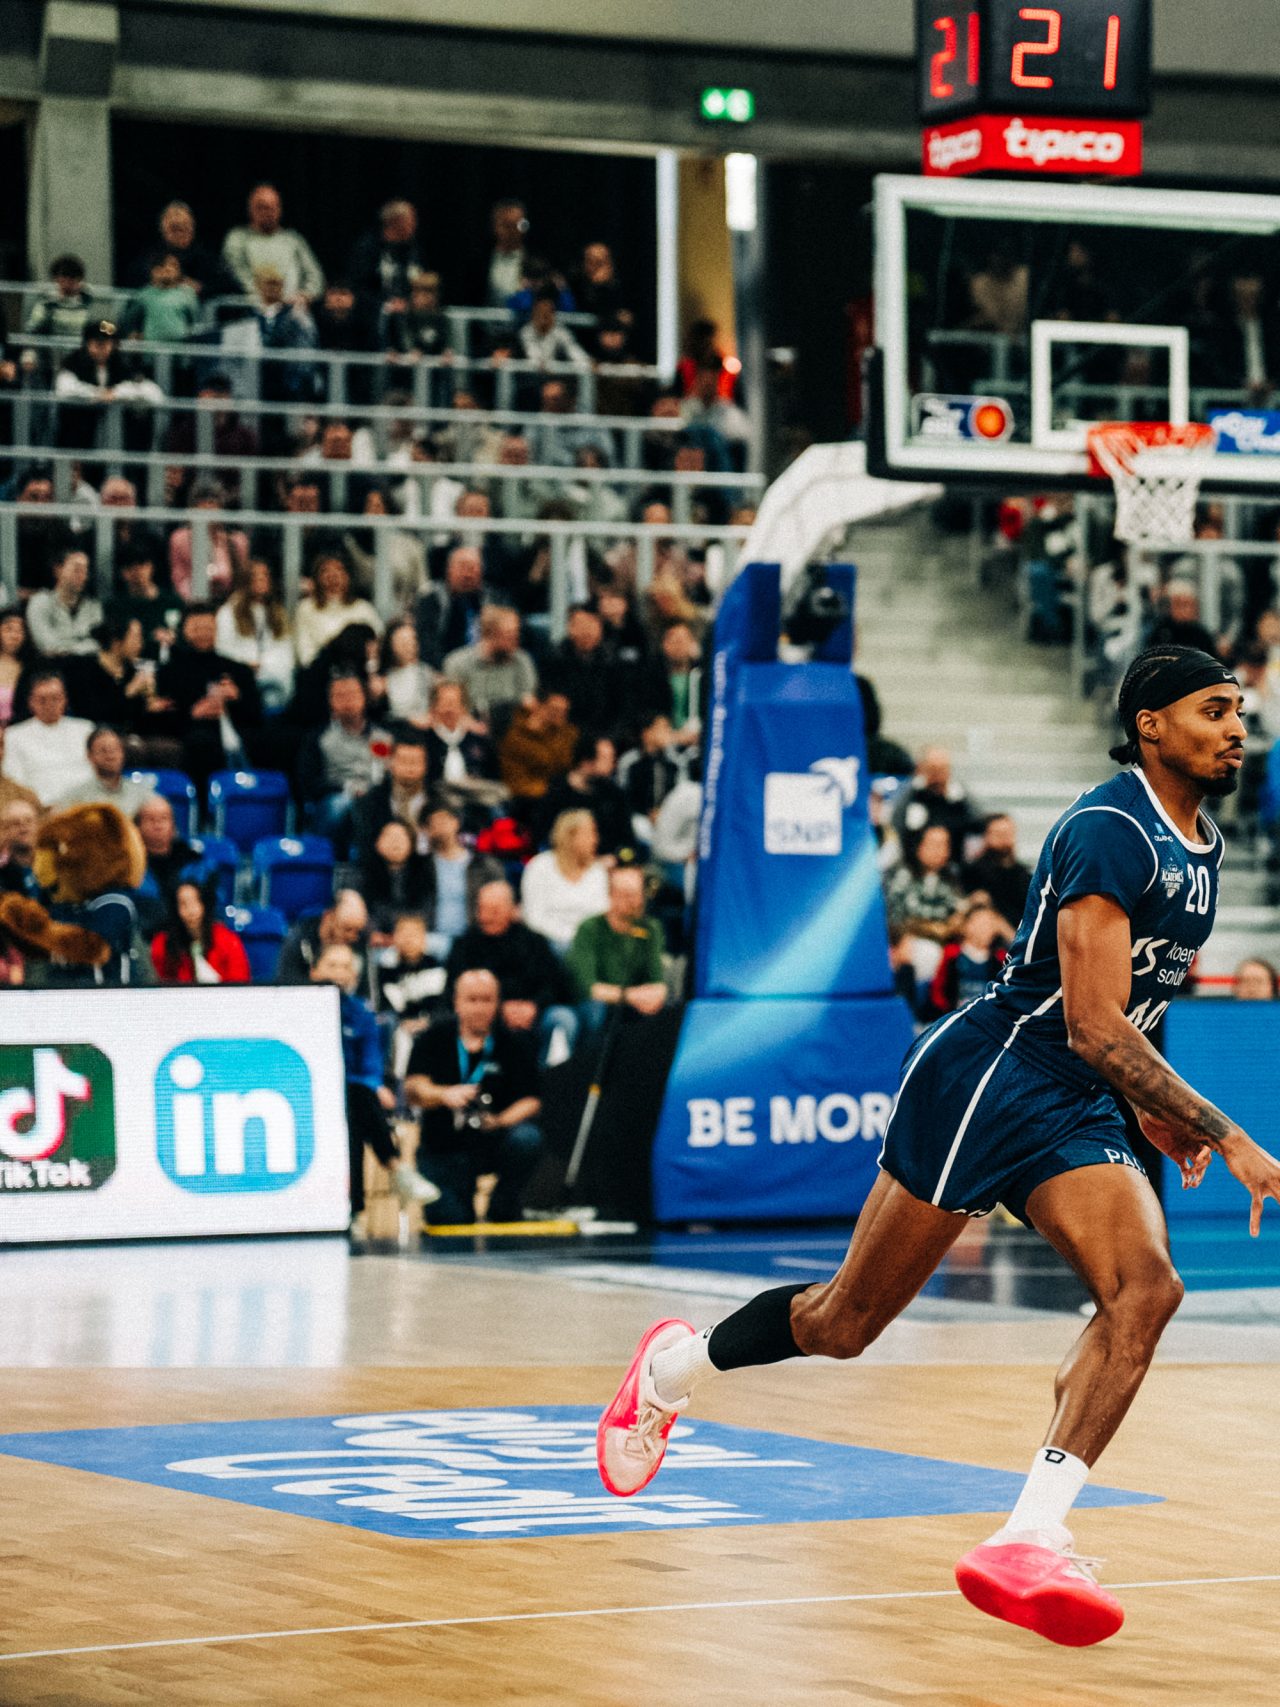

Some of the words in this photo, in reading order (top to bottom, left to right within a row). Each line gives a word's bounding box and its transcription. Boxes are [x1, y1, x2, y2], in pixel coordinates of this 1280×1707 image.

[930, 12, 980, 98] 21
[1011, 8, 1119, 90] 21
[1003, 117, 1125, 166] tipico
[1185, 863, 1210, 915] 20
[169, 1054, 298, 1176] in
[687, 1097, 757, 1148] BE
[769, 1091, 899, 1144] MOR
